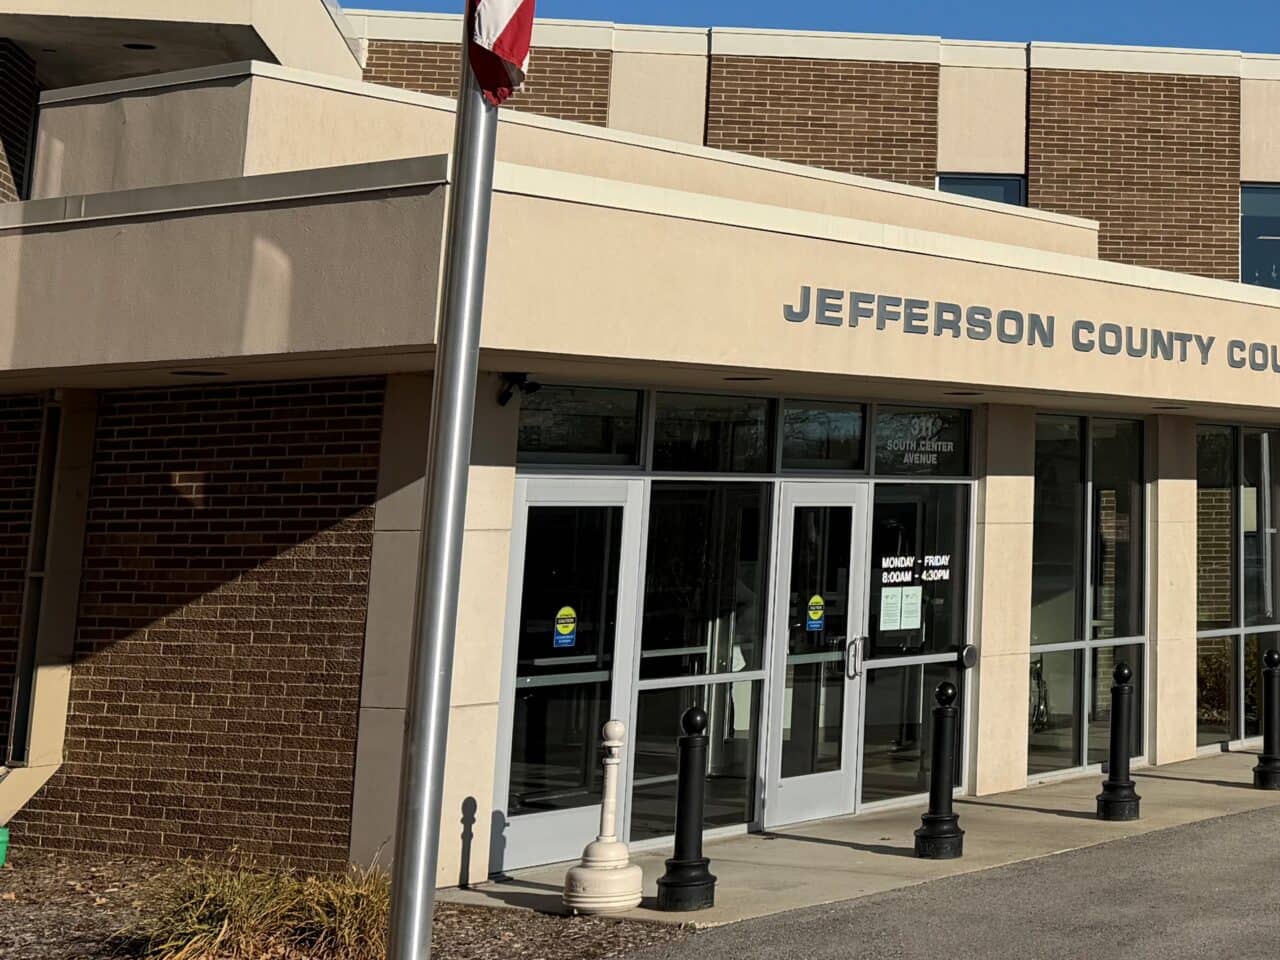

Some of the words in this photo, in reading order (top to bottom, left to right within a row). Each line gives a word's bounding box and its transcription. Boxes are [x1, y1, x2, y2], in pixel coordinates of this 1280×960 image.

[783, 285, 1055, 348] JEFFERSON
[1071, 320, 1215, 365] COUNTY
[887, 440, 917, 451] SOUTH
[920, 441, 954, 452] CENTER
[903, 452, 938, 464] AVENUE
[881, 556, 915, 569] MONDAY
[924, 554, 951, 567] FRIDAY
[881, 570, 912, 584] 8:00AM
[921, 568, 950, 582] 4:30PM
